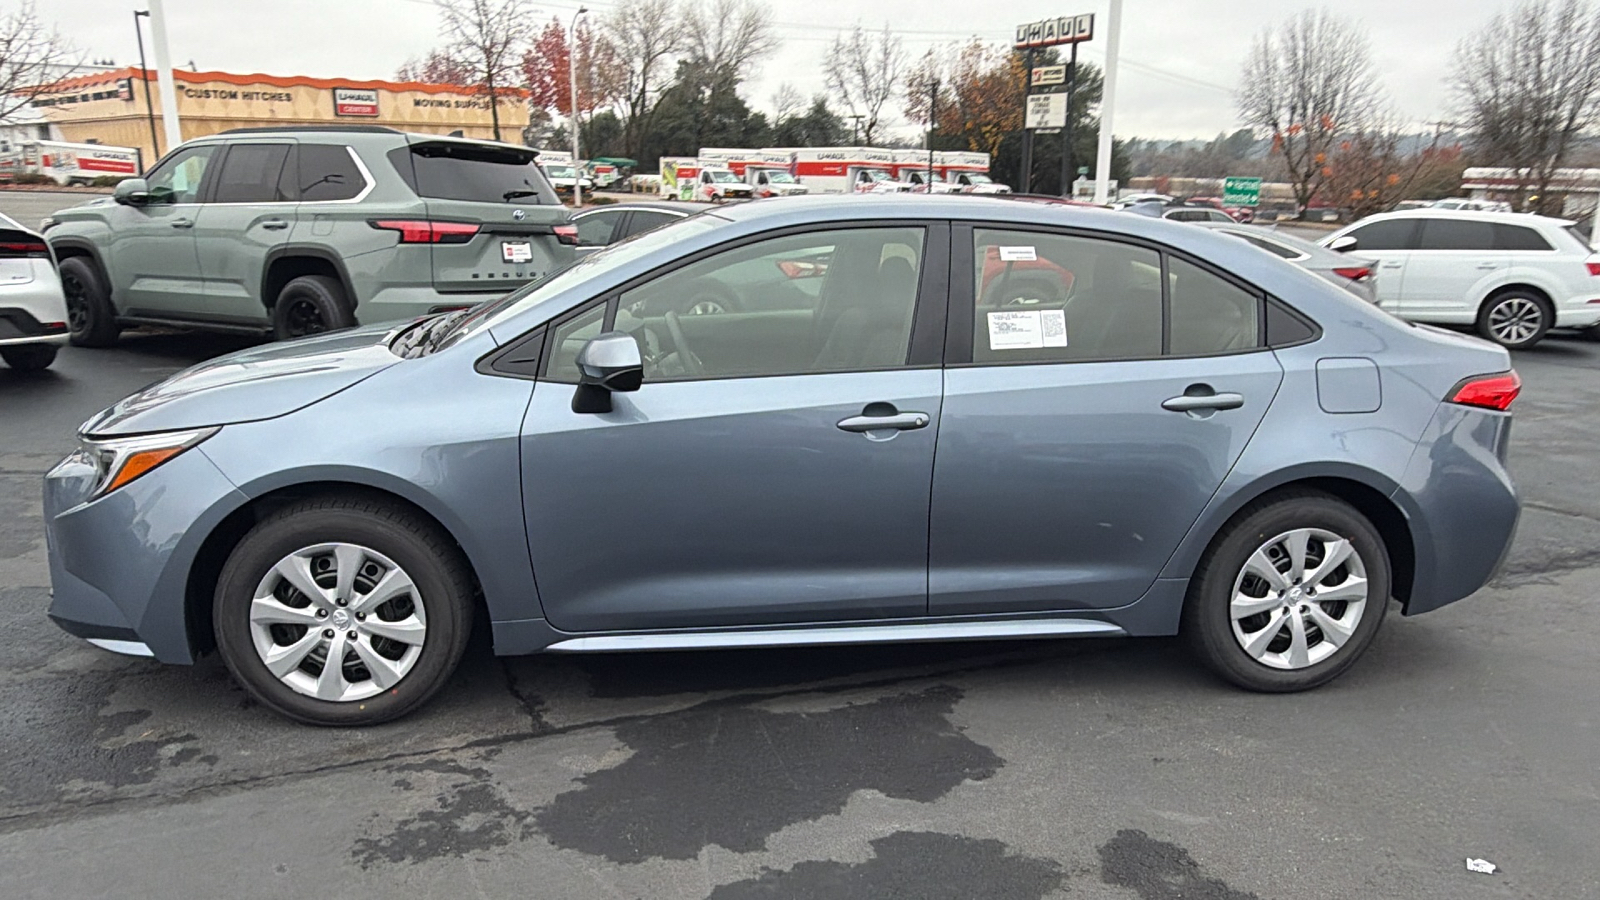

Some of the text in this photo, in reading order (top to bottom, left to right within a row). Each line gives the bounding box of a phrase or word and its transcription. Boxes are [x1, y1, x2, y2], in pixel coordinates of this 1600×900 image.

[185, 88, 293, 102] CUSTOM HITCHES
[413, 98, 452, 108] MOVING
